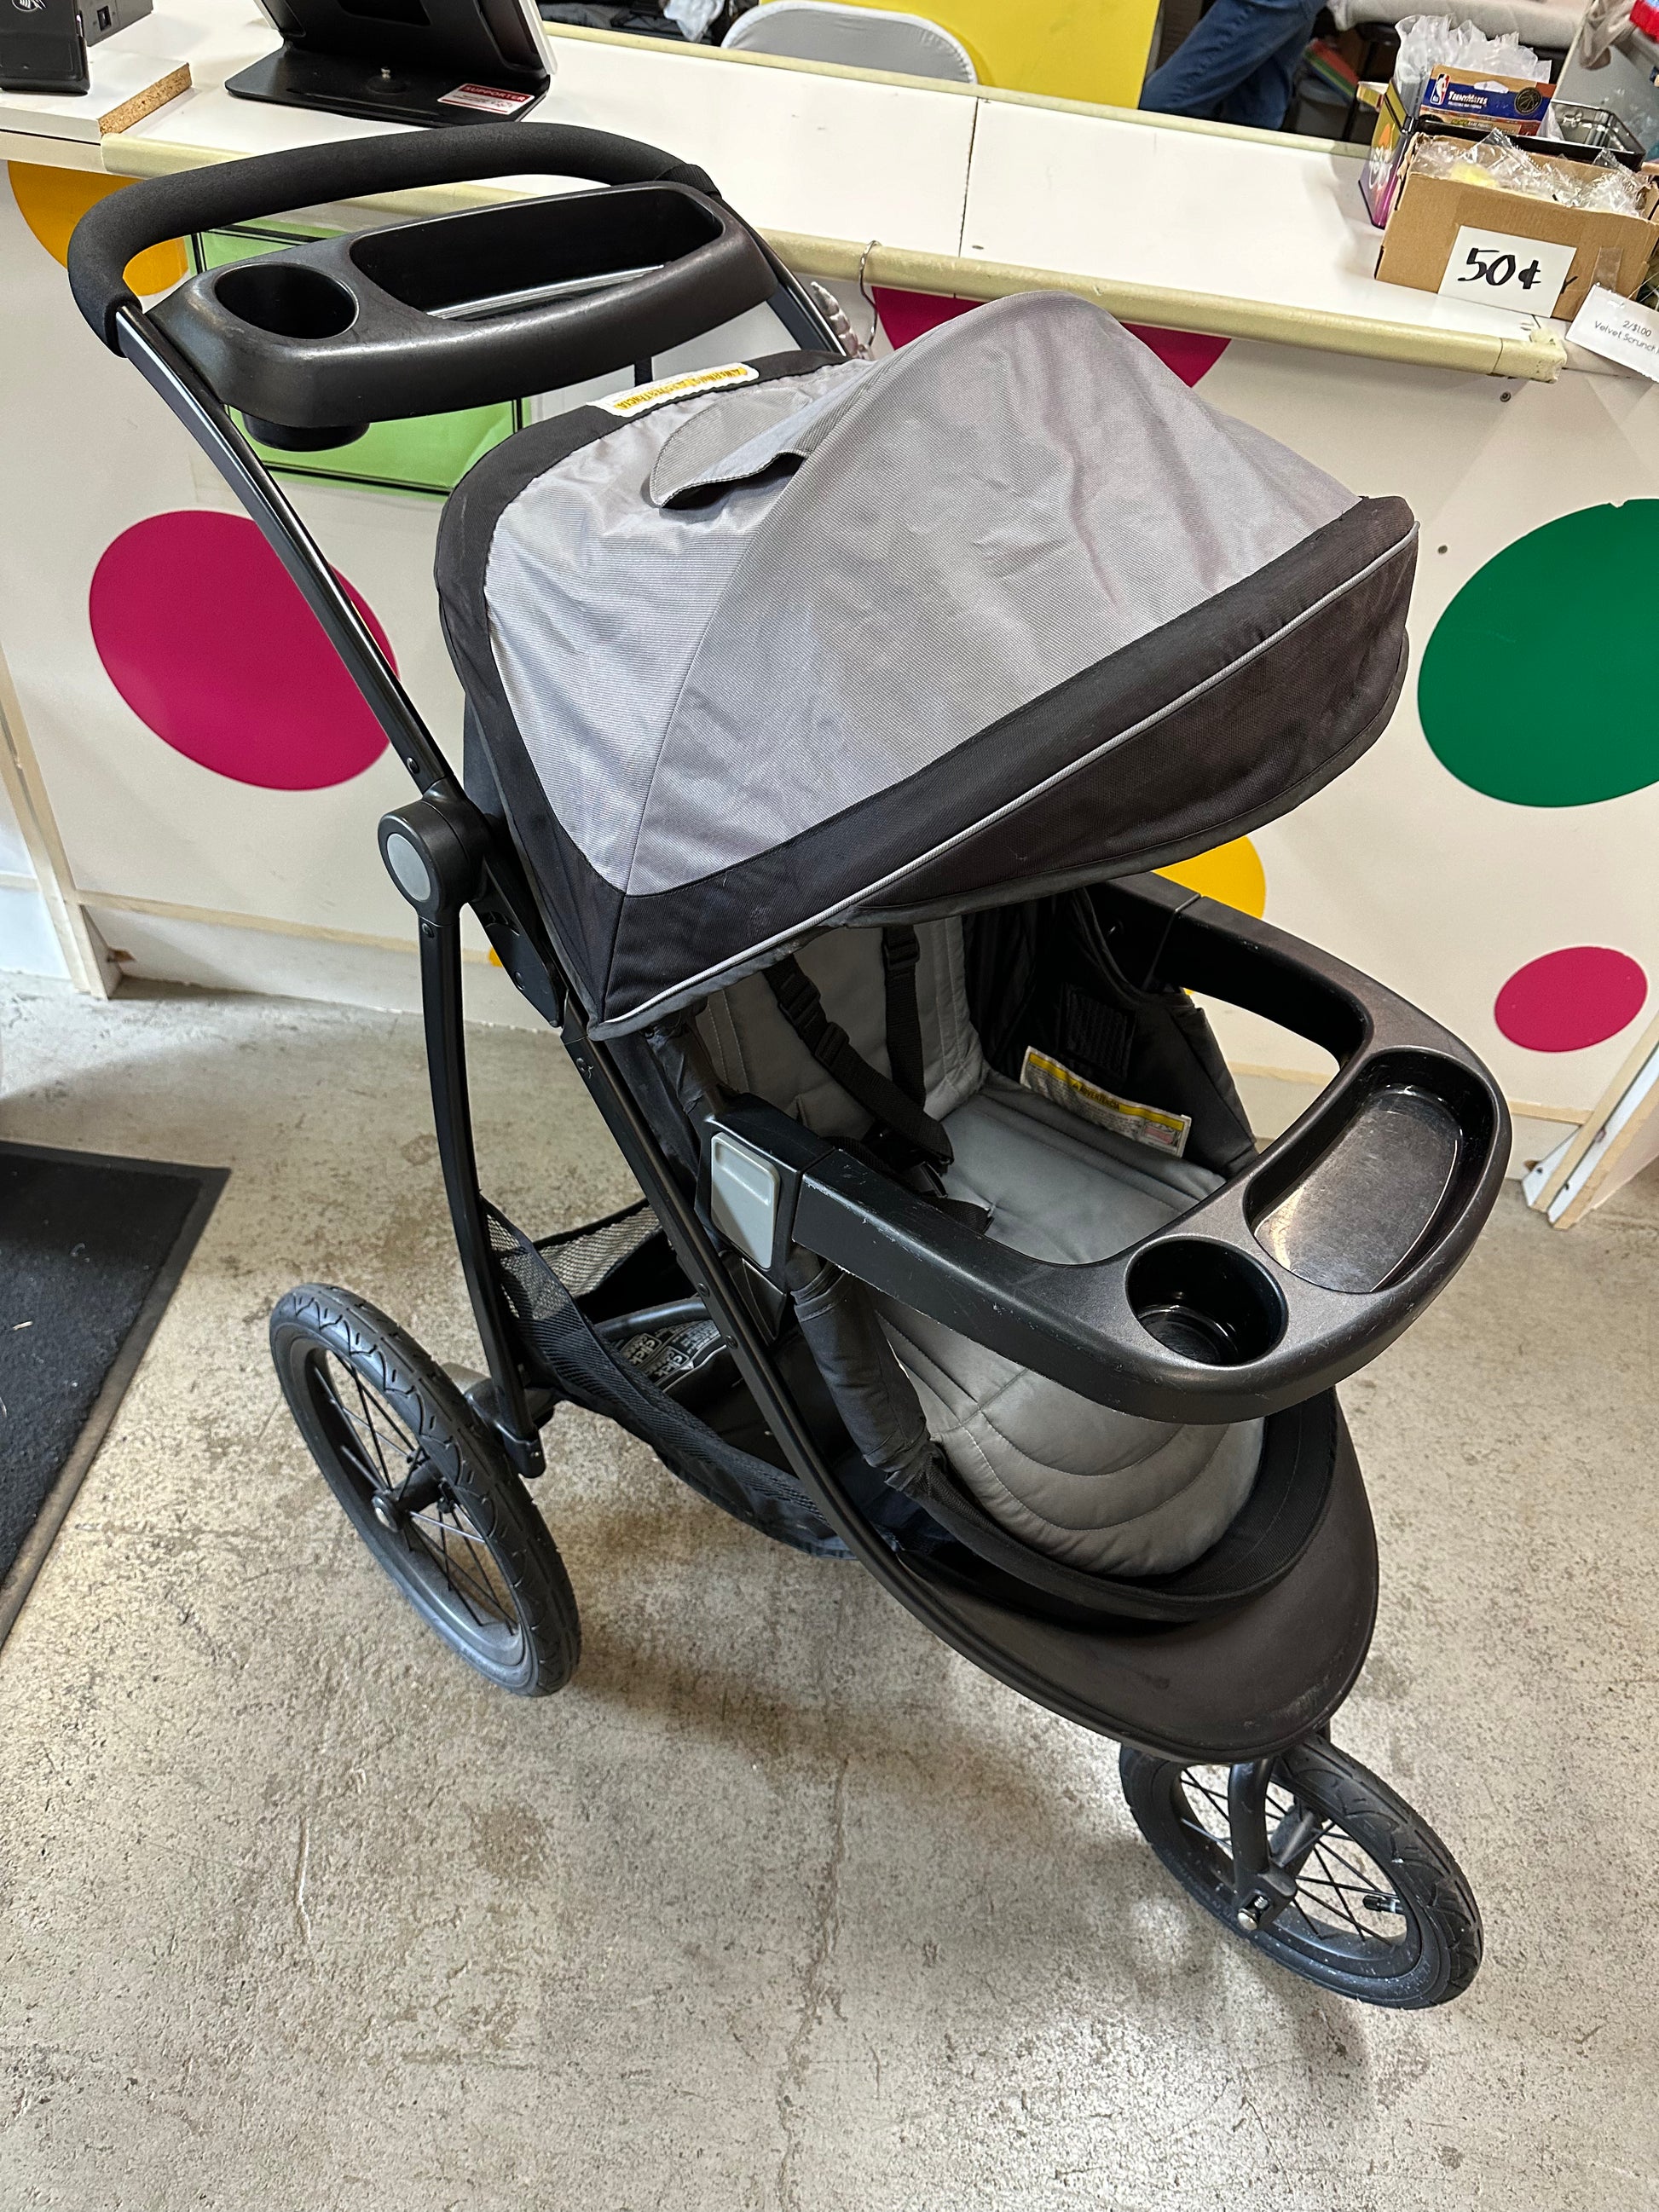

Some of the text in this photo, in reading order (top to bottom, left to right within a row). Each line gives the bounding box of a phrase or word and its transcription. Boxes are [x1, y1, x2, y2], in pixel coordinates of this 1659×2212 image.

[464, 85, 525, 101] SUPPORTER
[1457, 247, 1541, 290] 50¢
[1594, 320, 1621, 339] Velvet
